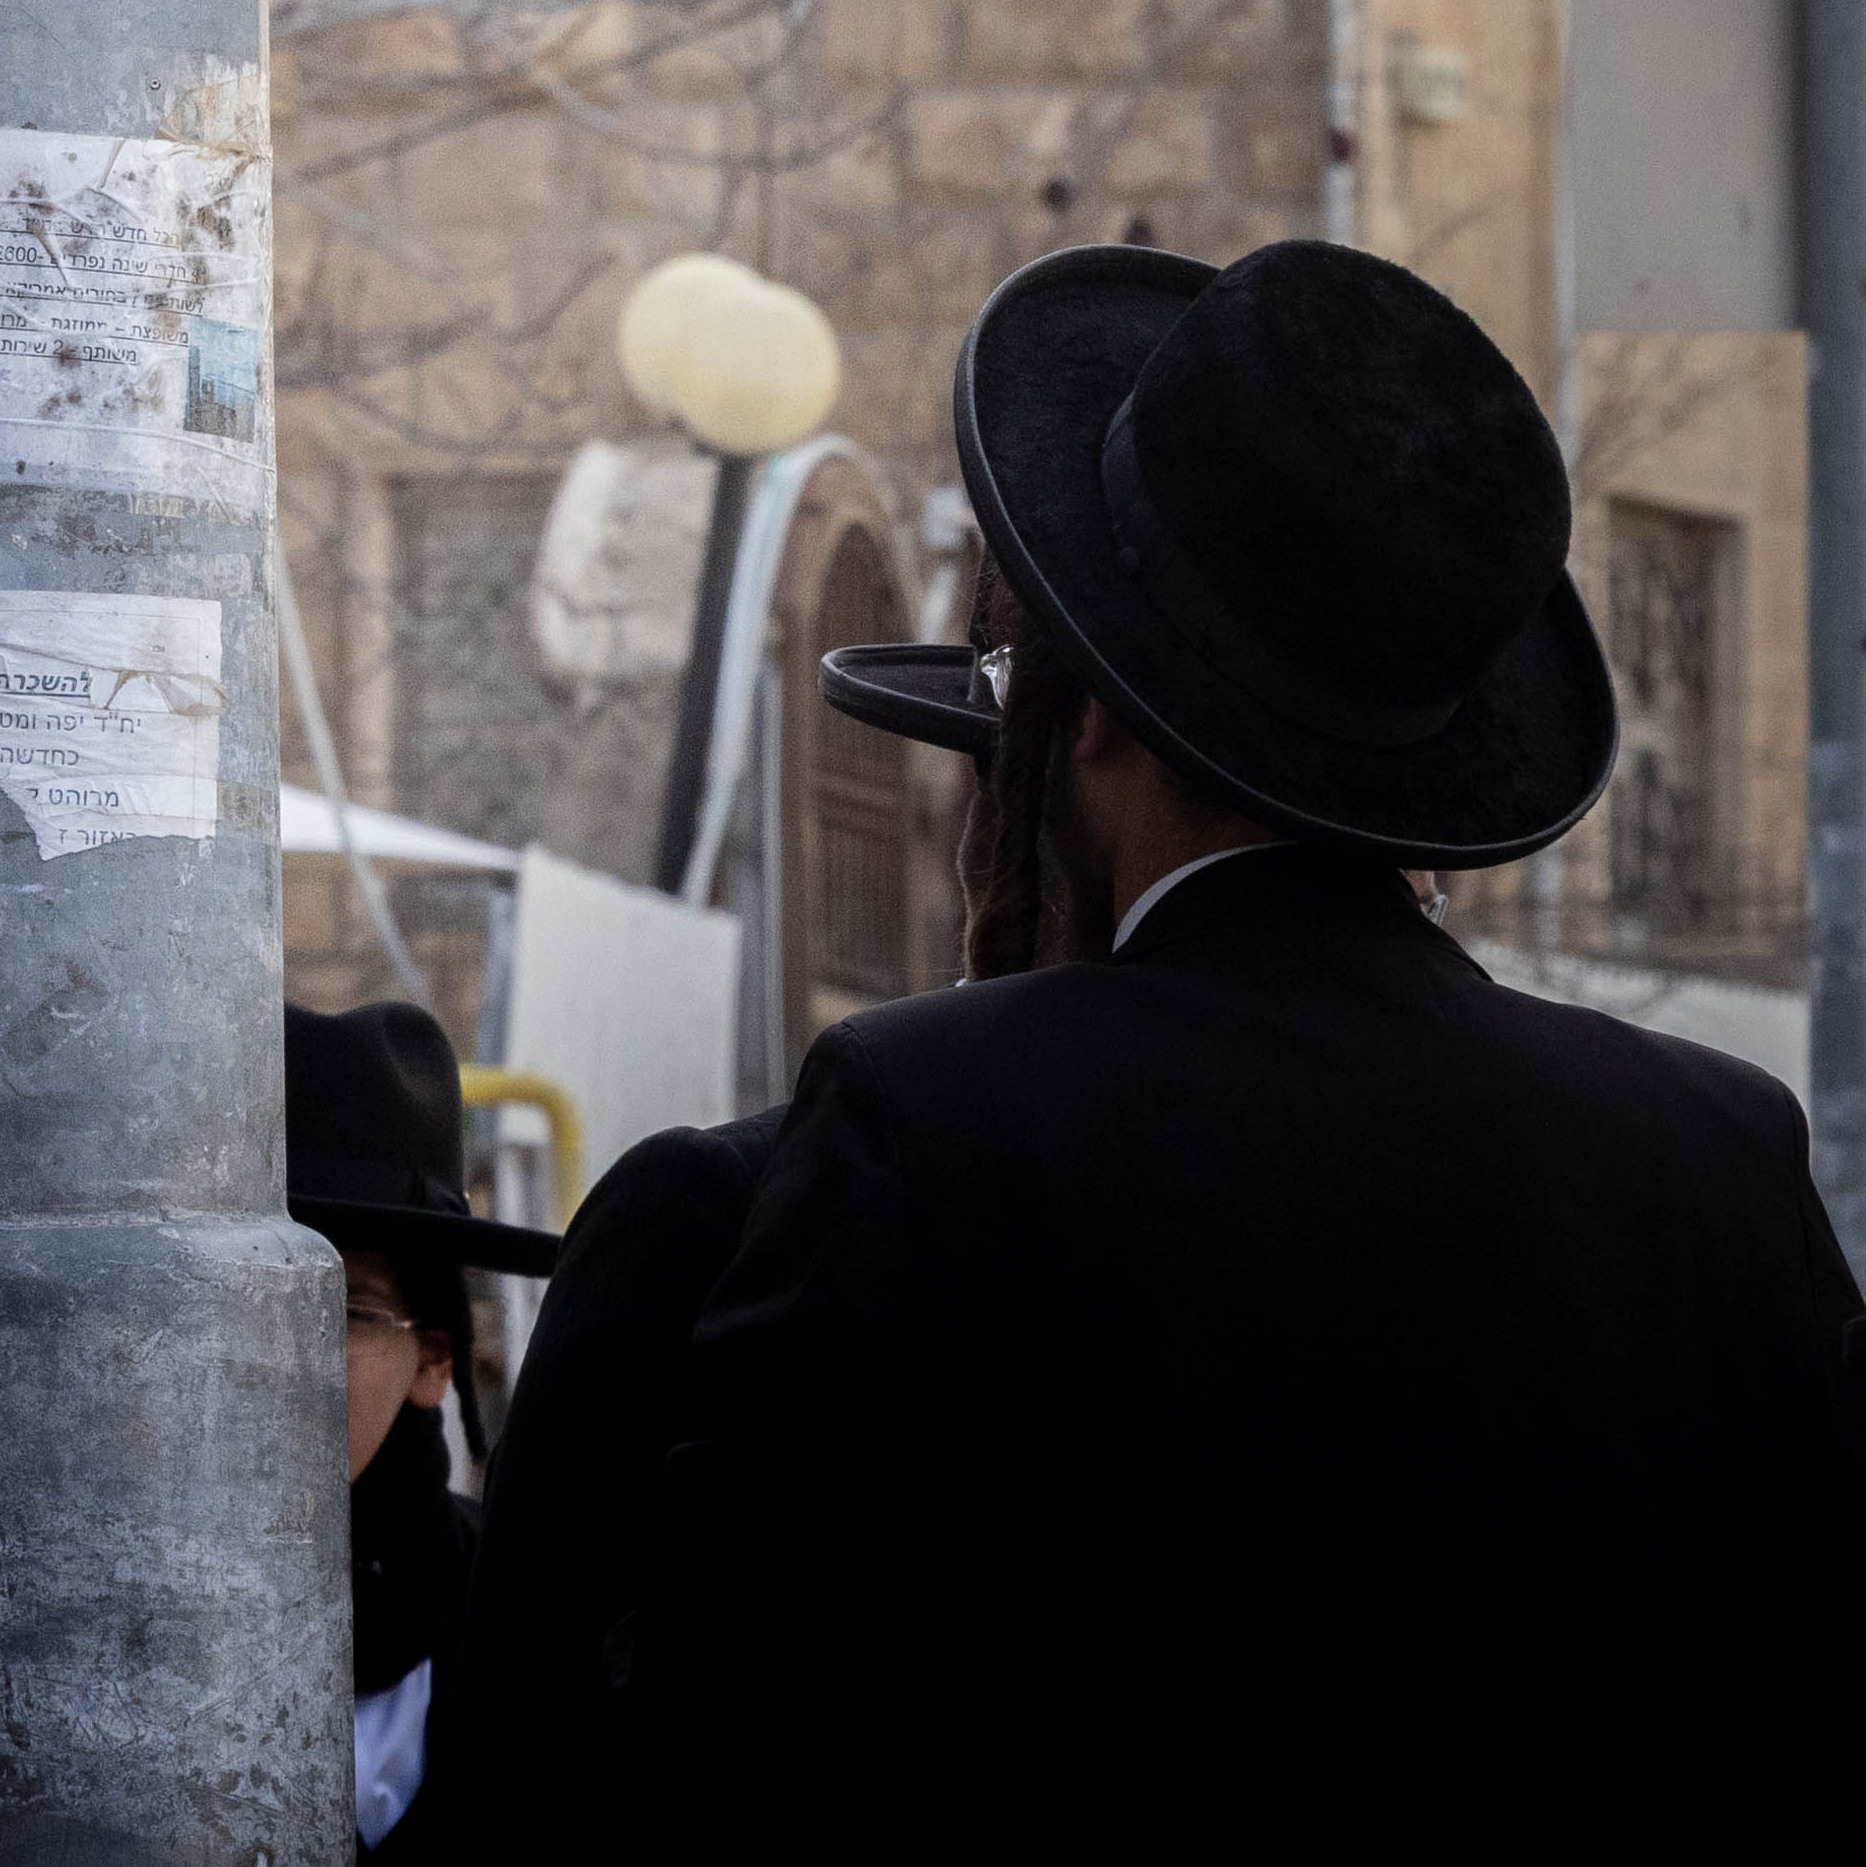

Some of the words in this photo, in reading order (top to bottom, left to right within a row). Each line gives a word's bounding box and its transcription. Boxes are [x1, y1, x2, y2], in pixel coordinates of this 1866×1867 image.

[46, 714, 84, 732] יפה
[0, 746, 81, 766] כחדשה
[49, 788, 119, 807] מרוהט
